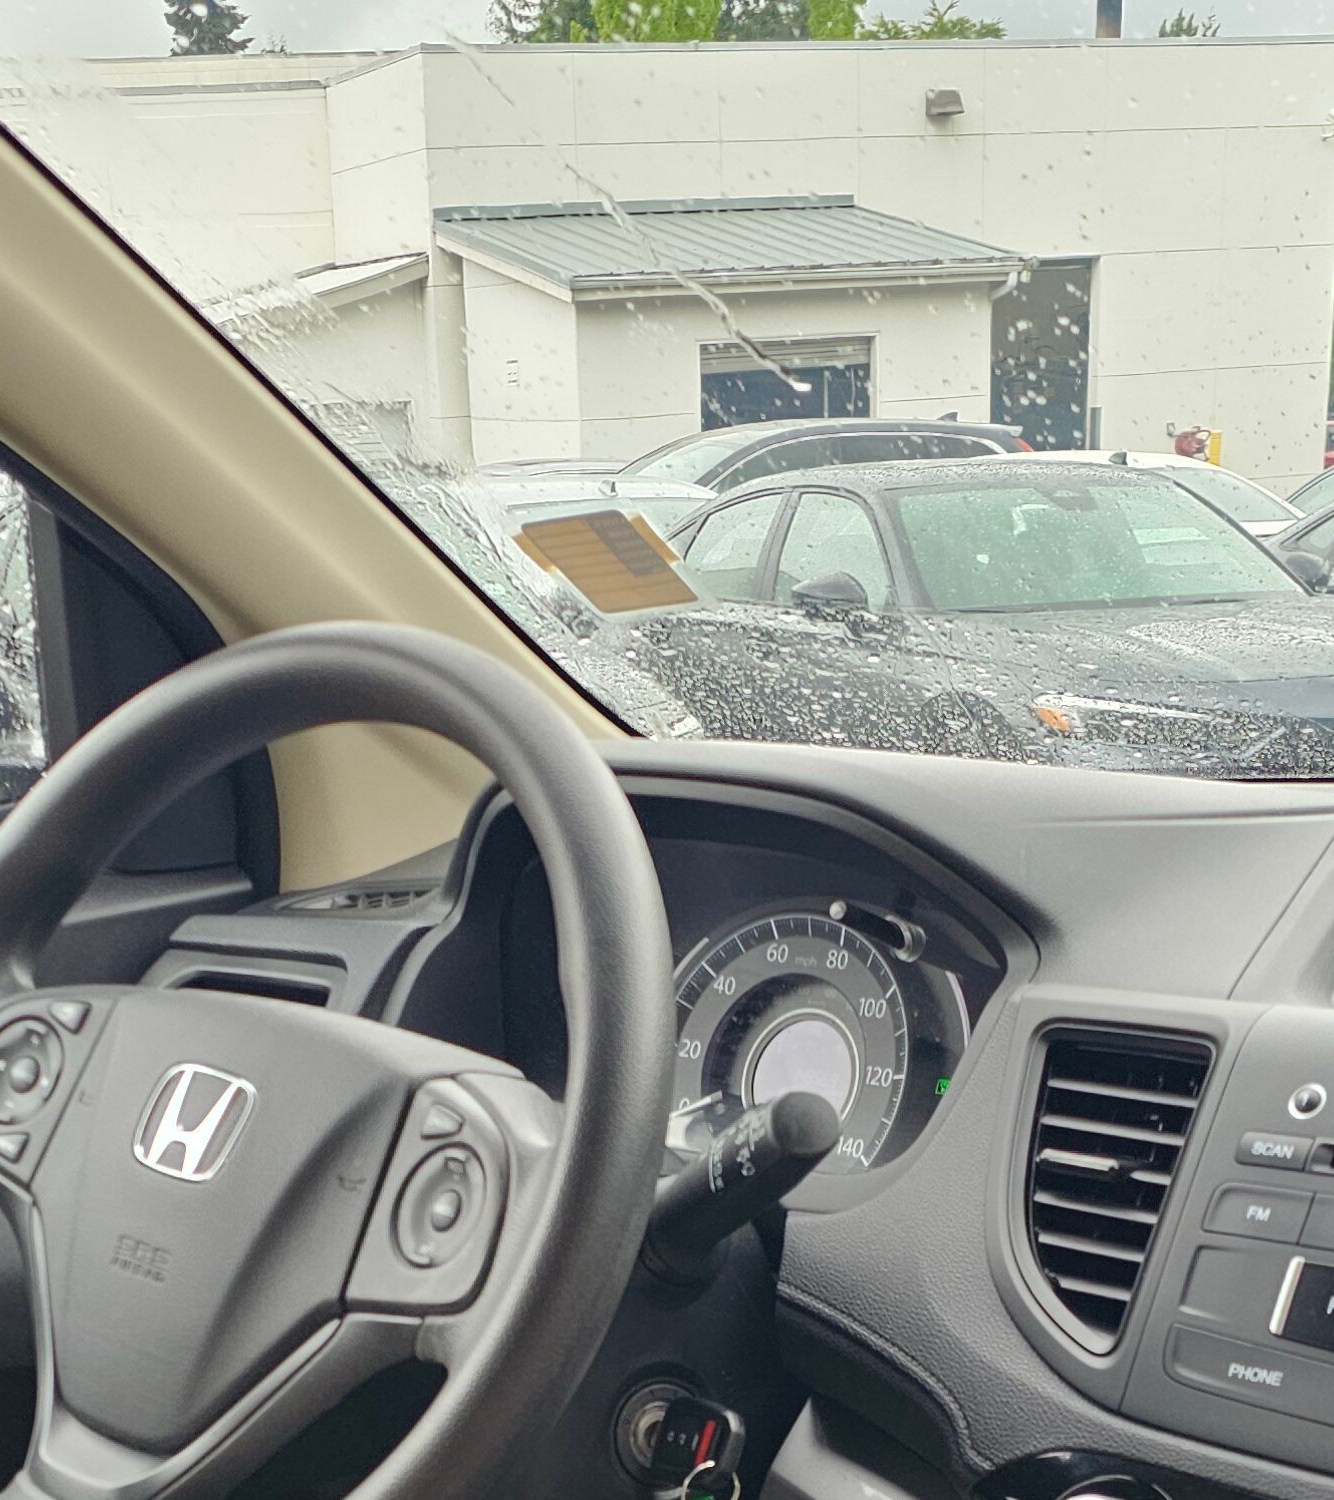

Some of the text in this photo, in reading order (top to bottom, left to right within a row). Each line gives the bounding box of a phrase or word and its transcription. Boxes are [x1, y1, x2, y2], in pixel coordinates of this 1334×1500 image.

[766, 942, 789, 964] 60
[825, 948, 849, 971] 80
[713, 976, 736, 996] 40
[859, 997, 886, 1019] 100
[678, 1039, 701, 1060] 20
[866, 1065, 893, 1088] 120
[837, 1136, 864, 1158] 140
[1251, 1141, 1294, 1160] SCAN
[1246, 1205, 1271, 1222] FM
[1227, 1362, 1284, 1387] PHONE
